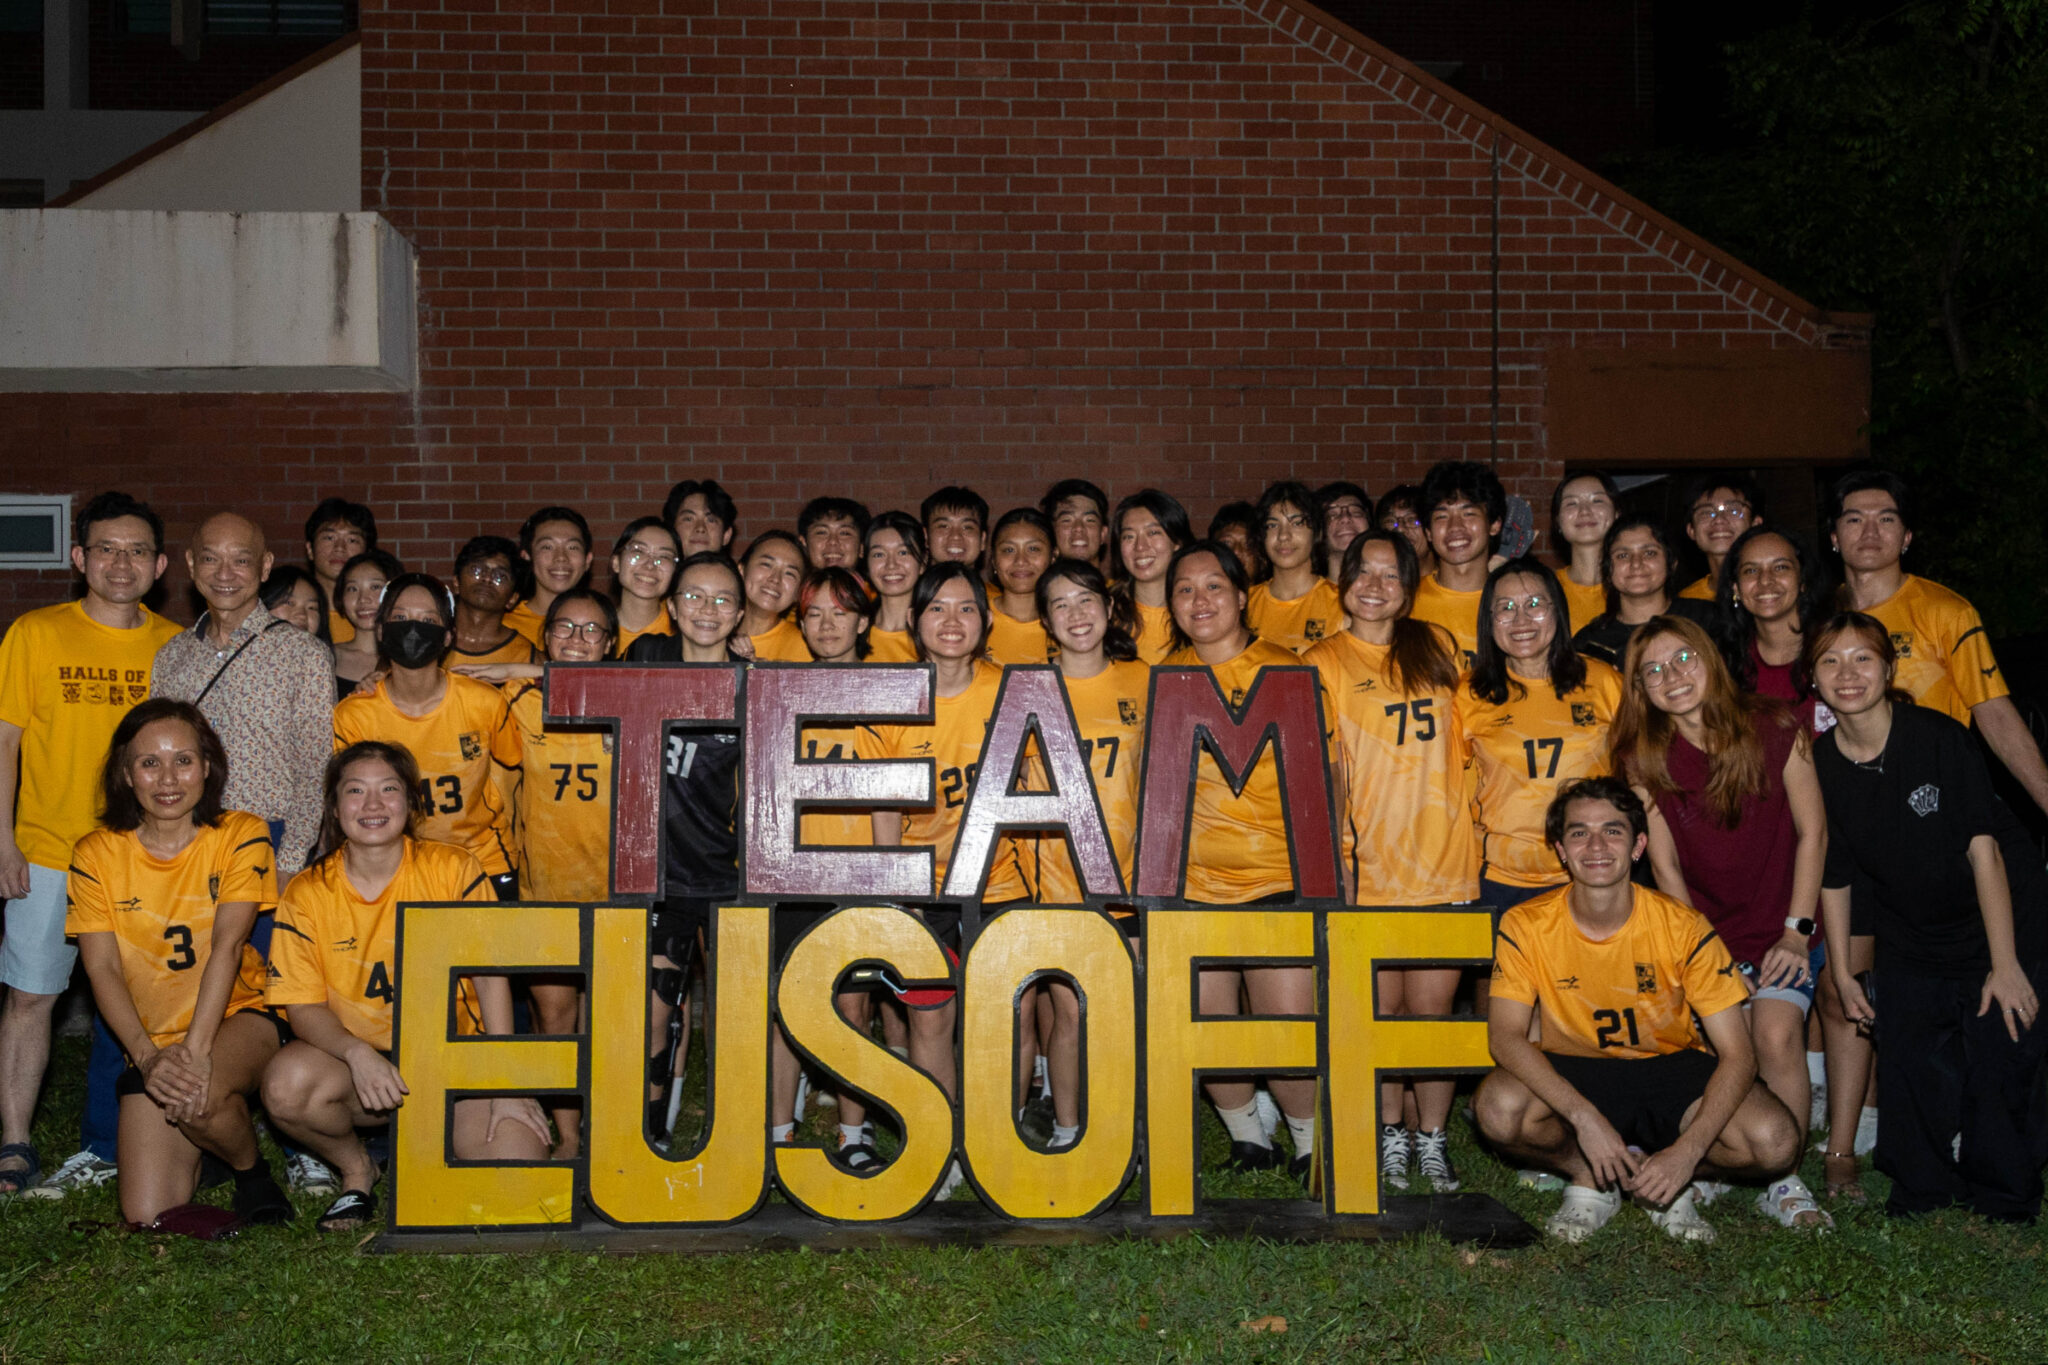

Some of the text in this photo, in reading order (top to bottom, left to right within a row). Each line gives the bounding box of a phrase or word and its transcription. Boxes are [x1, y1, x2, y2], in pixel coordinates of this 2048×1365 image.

[59, 666, 145, 683] HALLS OF
[1384, 698, 1436, 746] 75
[1523, 737, 1564, 779] 17
[544, 661, 1344, 904] TEAM
[550, 763, 598, 801] 75
[164, 925, 196, 971] 3
[364, 960, 394, 1004] 4
[1593, 1008, 1640, 1049] 21
[392, 902, 1496, 1228] EUSOFF
